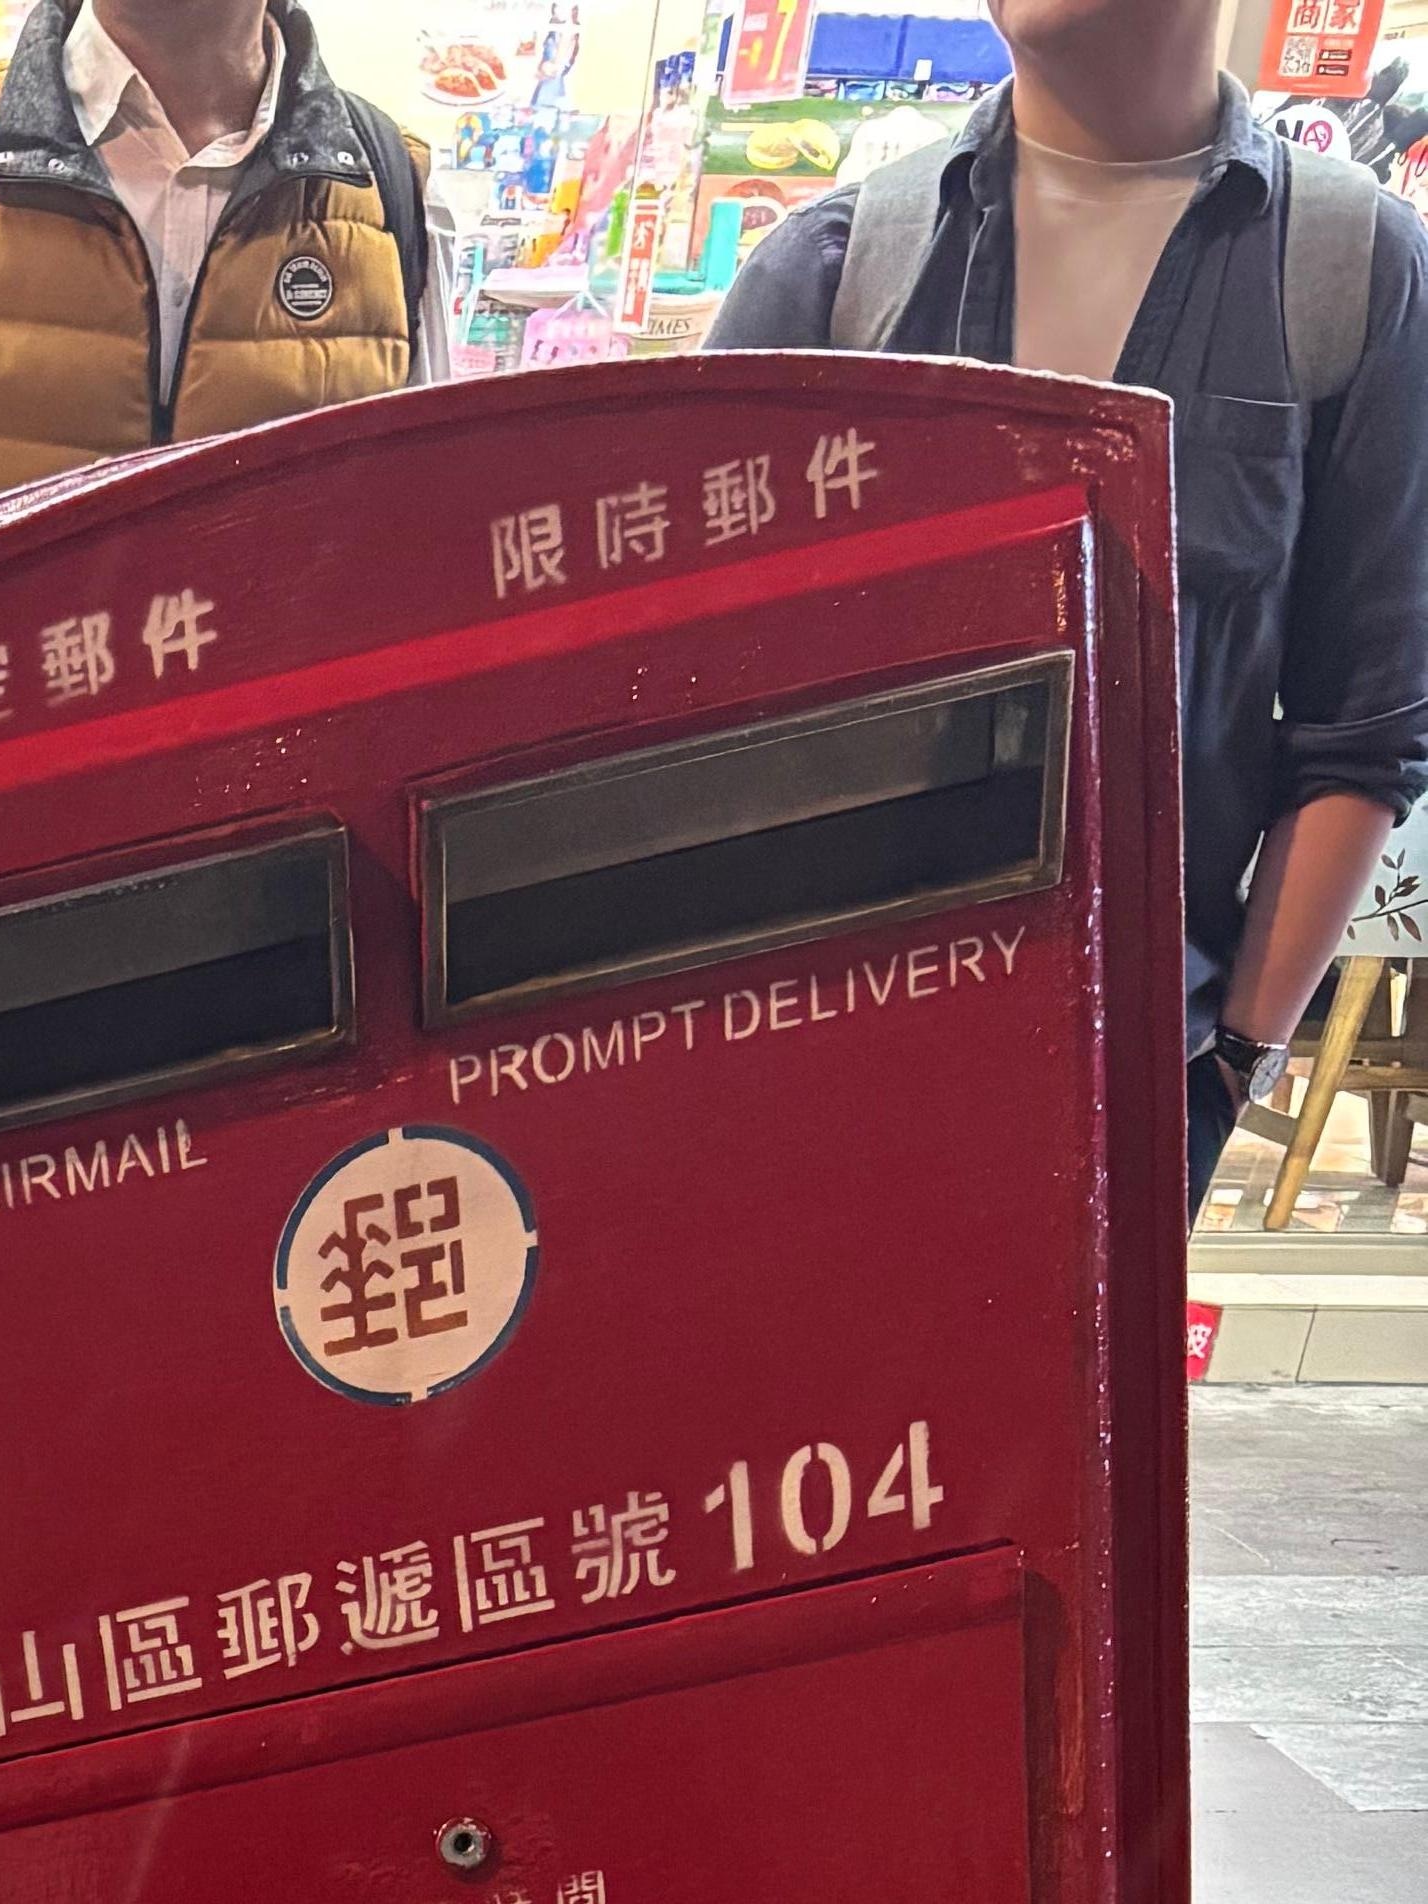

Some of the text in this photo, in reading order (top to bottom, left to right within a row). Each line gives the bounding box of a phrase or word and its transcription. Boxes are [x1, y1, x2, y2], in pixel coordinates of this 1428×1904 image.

[492, 428, 877, 598] 限時郵件
[449, 926, 1027, 1104] PROMPT DELIVERY
